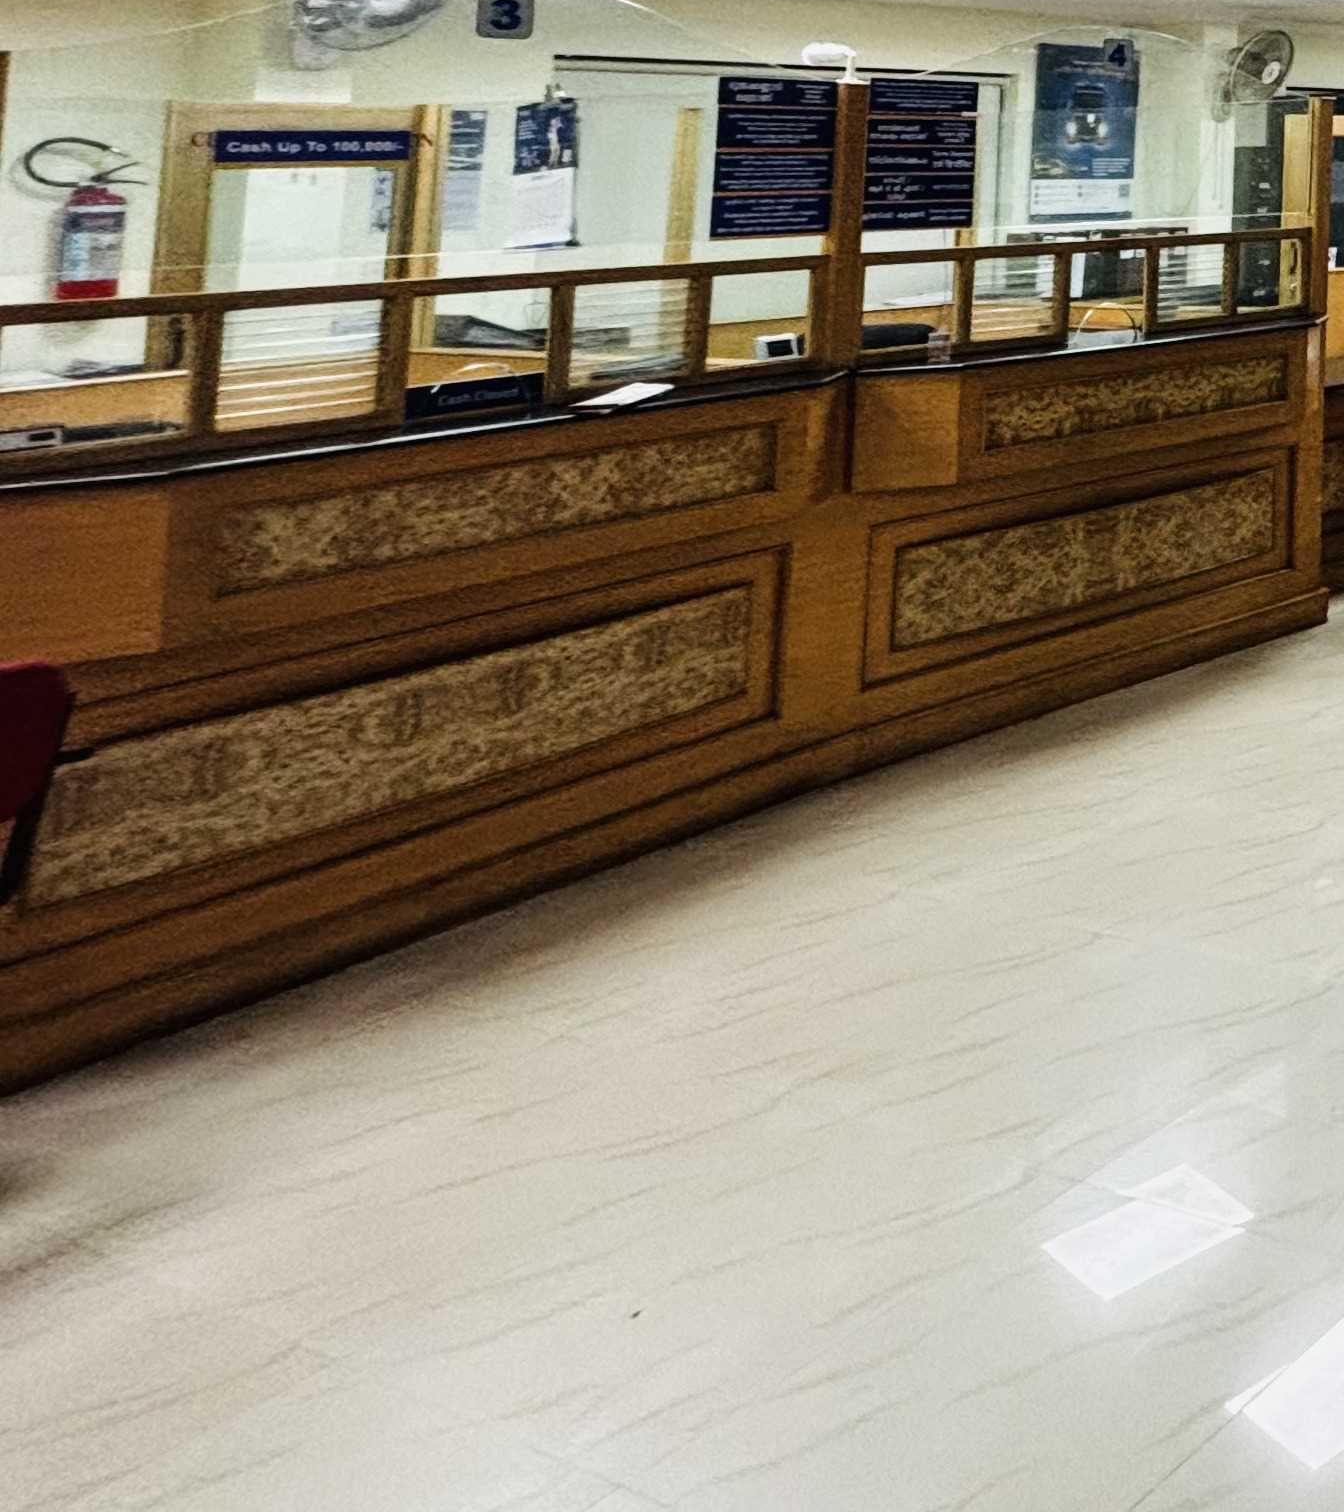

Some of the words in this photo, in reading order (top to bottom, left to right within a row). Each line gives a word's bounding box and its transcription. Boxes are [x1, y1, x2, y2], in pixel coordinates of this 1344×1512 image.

[1108, 42, 1128, 67] 4
[225, 141, 273, 153] Cash
[277, 141, 301, 155] Up
[306, 140, 328, 153] To
